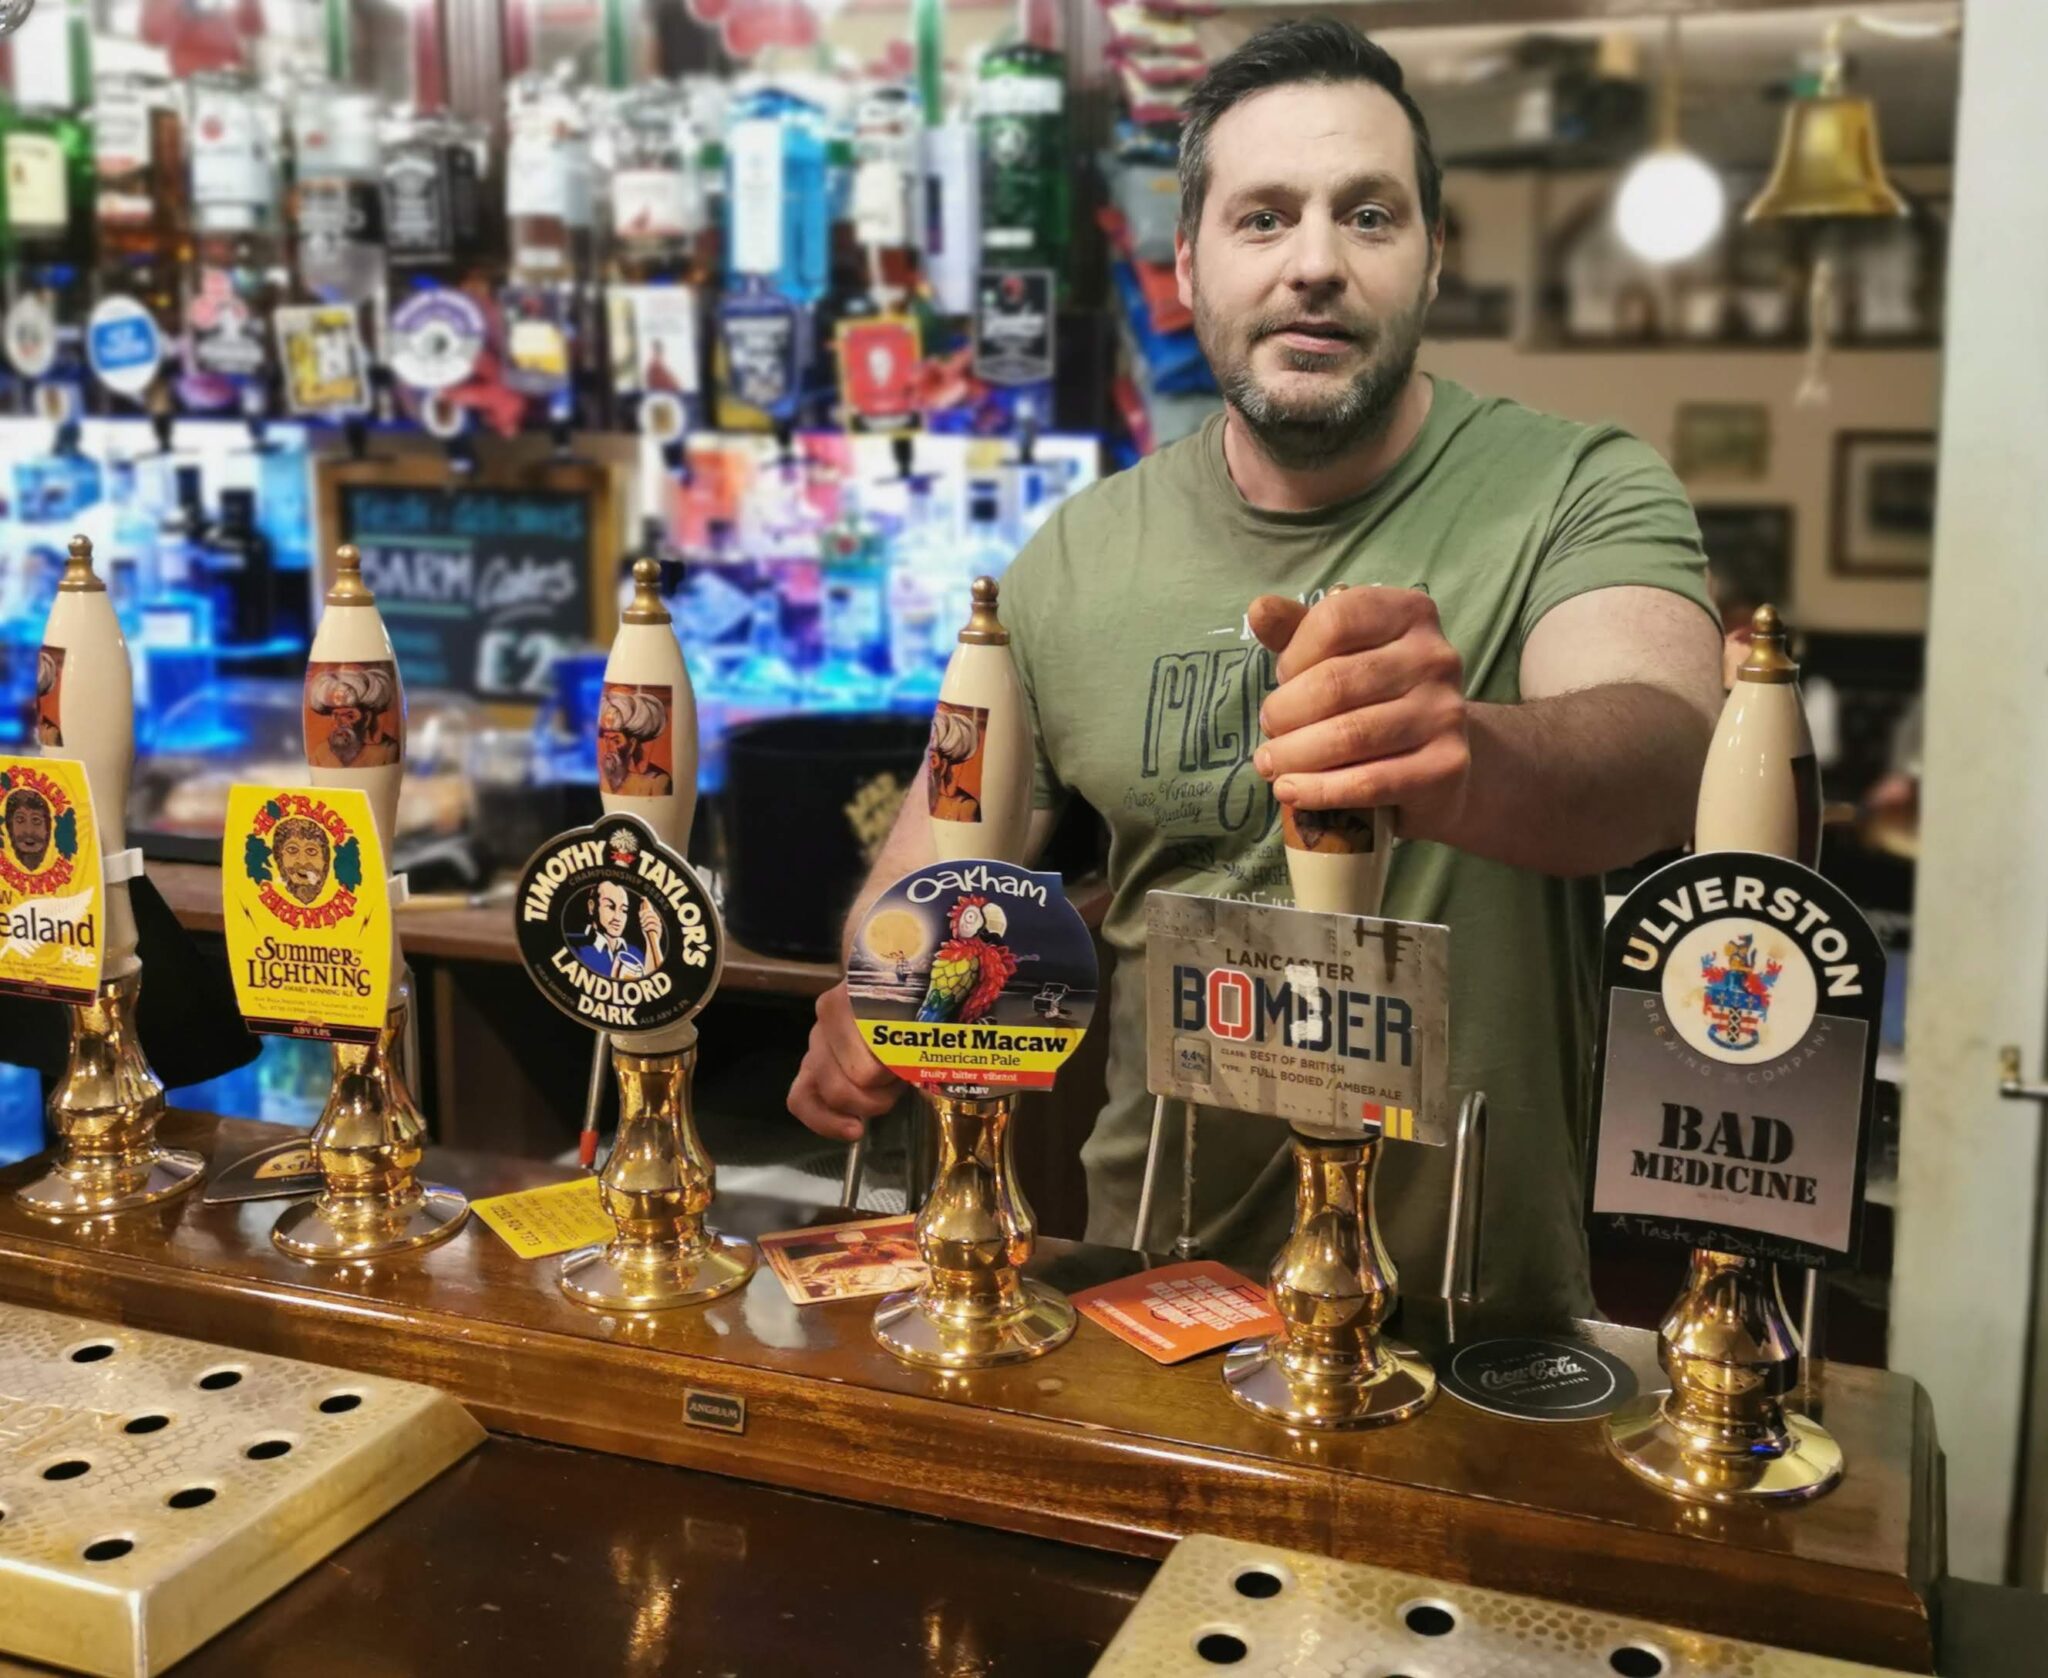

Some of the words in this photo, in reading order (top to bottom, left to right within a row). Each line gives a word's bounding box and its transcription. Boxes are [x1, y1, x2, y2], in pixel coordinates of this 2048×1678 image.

[524, 840, 606, 922] TIMOTHY
[638, 850, 712, 968] TAYLOR'S
[0, 907, 95, 947] ealand
[1621, 876, 1864, 998] ULVERSTON
[255, 936, 361, 967] Summer
[1225, 948, 1355, 983] LANCASTER
[551, 946, 672, 1006] LANDLORD
[577, 994, 637, 1026] DARK
[1172, 964, 1413, 1067] BOMBER
[872, 1024, 967, 1051] Scarlet
[972, 1030, 1068, 1053] Macaw
[919, 1050, 988, 1067] American
[990, 1053, 1021, 1067] Pale
[951, 1070, 978, 1081] bitter
[982, 1072, 1018, 1082] vibrant
[1250, 1050, 1276, 1065] BEST
[1281, 1055, 1296, 1065] OF
[1300, 1058, 1346, 1075] BRITISH
[968, 1085, 990, 1095] ABV
[1251, 1065, 1277, 1080] FULL
[1280, 1069, 1324, 1087] BODIED
[1334, 1080, 1376, 1097] AMBER
[1379, 1087, 1403, 1100] ALE
[1658, 1102, 1794, 1165] BAD
[1630, 1150, 1817, 1205] MEDICINE
[1611, 1215, 1629, 1234] A
[1636, 1218, 1694, 1245] Taste
